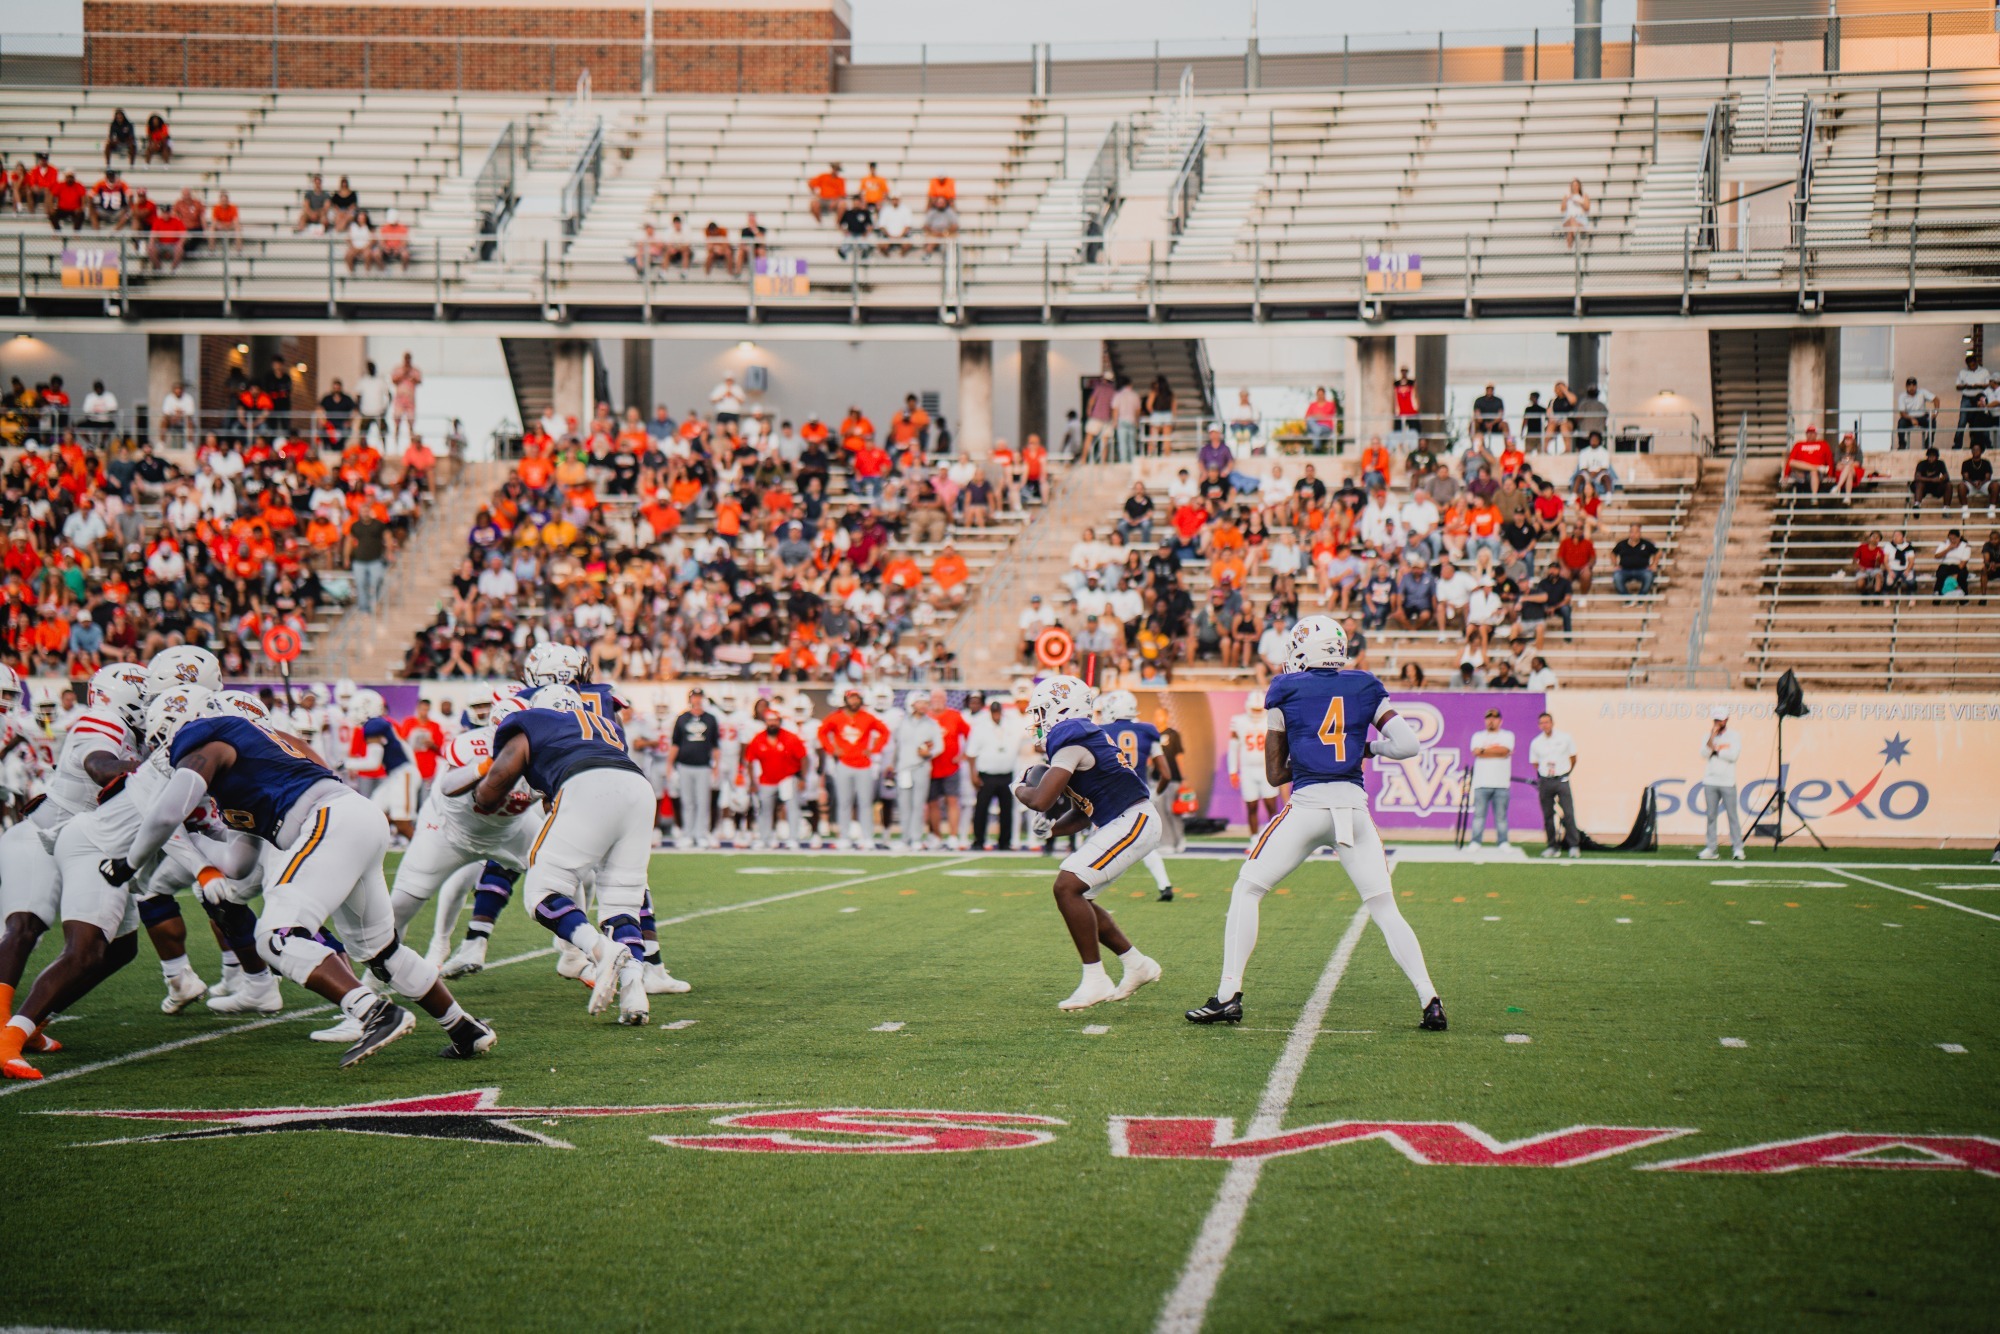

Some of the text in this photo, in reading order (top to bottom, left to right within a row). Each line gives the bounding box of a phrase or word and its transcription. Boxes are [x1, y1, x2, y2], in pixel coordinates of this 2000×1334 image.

[1317, 696, 1347, 762] 4
[1600, 702, 1614, 720] A
[1617, 702, 1693, 721] PROUD
[1827, 702, 1858, 721] OF
[1861, 702, 1946, 722] PRAIRIE
[1949, 702, 2000, 722] VIEW
